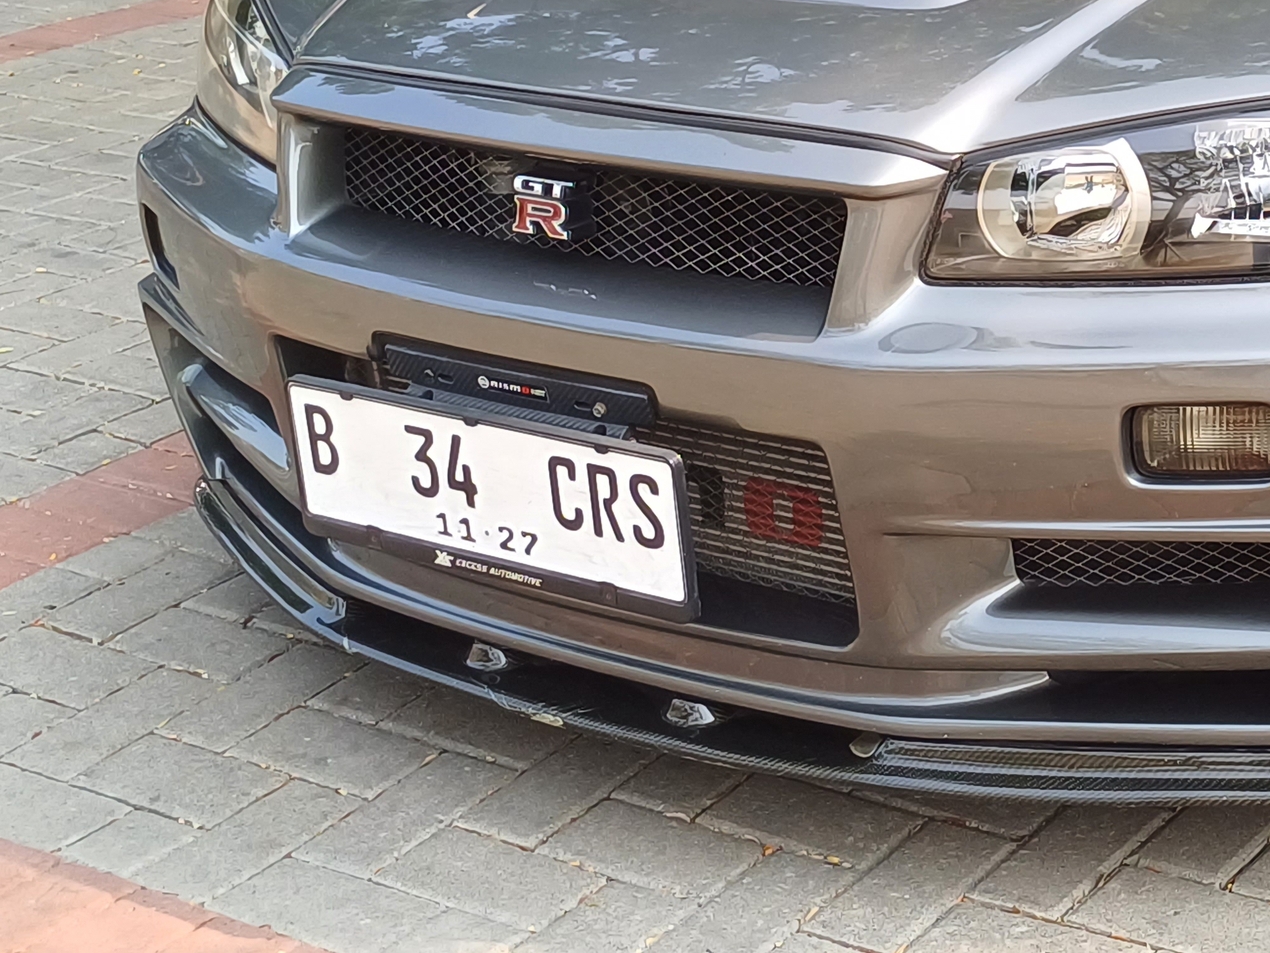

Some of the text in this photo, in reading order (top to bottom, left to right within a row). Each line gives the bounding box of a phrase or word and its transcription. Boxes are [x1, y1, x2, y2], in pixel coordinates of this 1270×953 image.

[514, 175, 576, 199] GT
[513, 195, 571, 240] R
[305, 403, 339, 475] B
[404, 424, 478, 508] 34
[547, 455, 665, 549] CRS
[489, 567, 543, 587] AUTOMOTIVE
